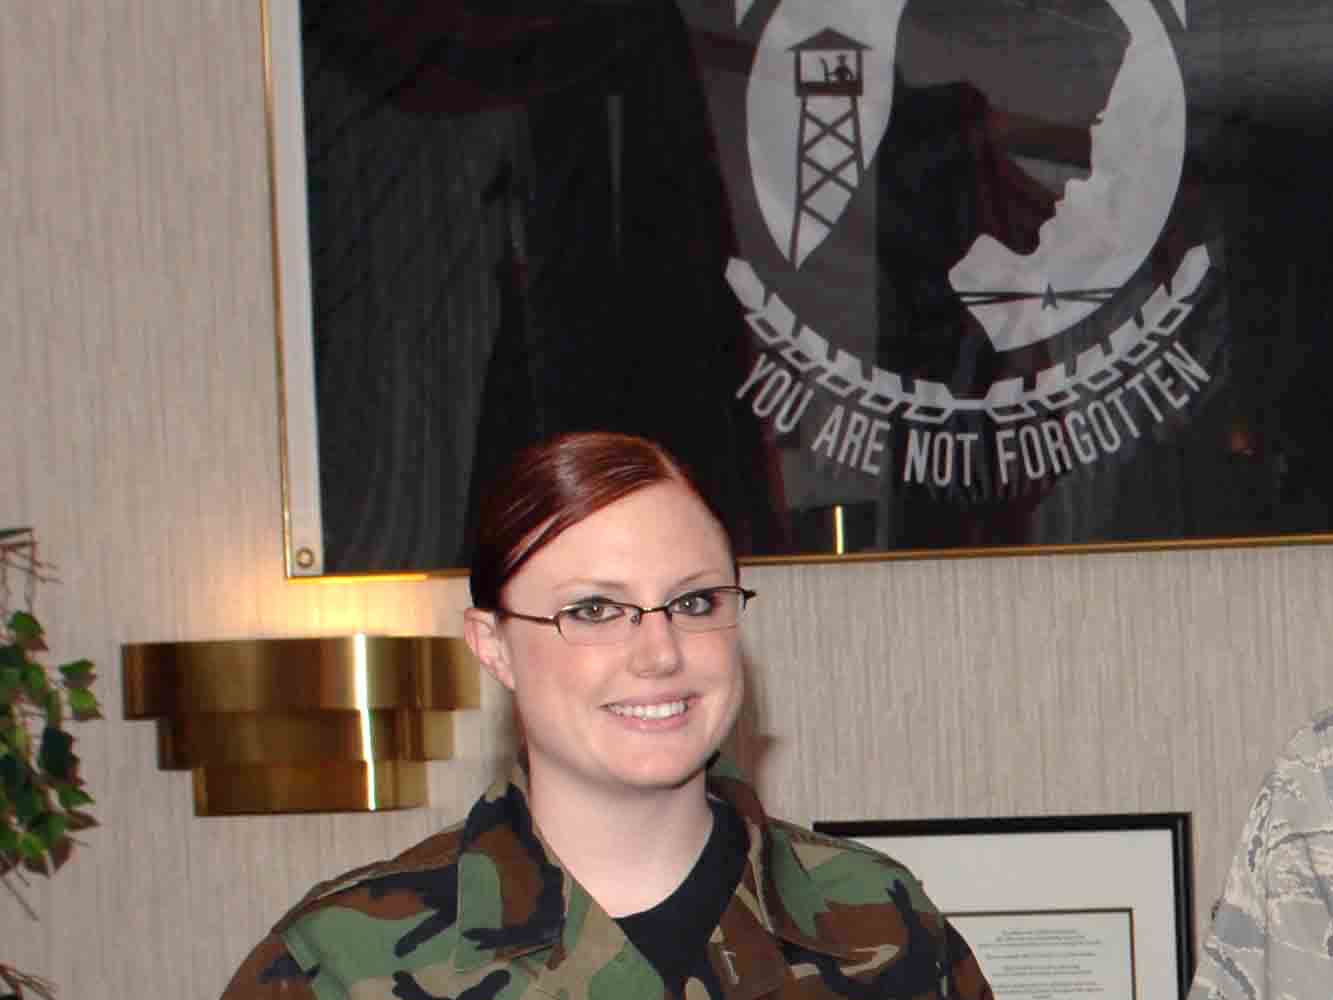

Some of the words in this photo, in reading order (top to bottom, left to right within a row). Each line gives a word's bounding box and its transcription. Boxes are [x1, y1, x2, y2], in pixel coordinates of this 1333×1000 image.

[736, 355, 802, 434] YOU
[811, 405, 890, 475] ARE
[904, 430, 978, 488] NOT
[1000, 341, 1211, 487] FORGOTTEN
